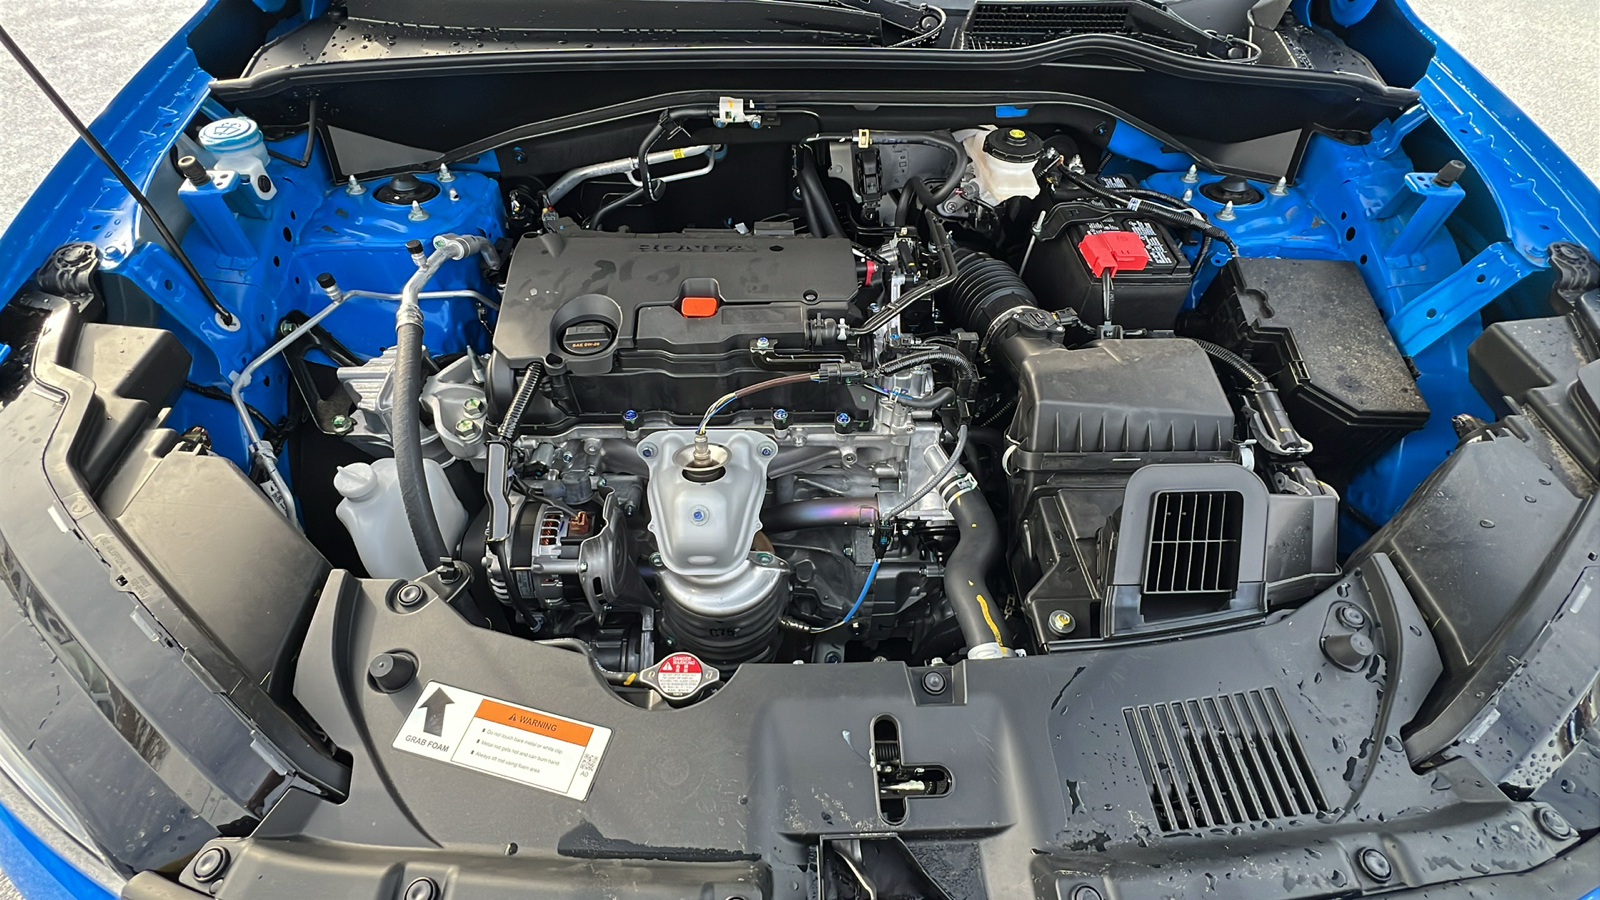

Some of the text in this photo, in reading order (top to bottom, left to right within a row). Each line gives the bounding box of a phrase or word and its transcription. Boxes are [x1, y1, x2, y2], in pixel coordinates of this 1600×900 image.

[519, 715, 557, 731] WARNING
[405, 734, 450, 752] GRAB FOAM
[542, 744, 554, 752] white
[475, 751, 491, 760] Always
[505, 760, 518, 768] using
[518, 762, 529, 770] foam
